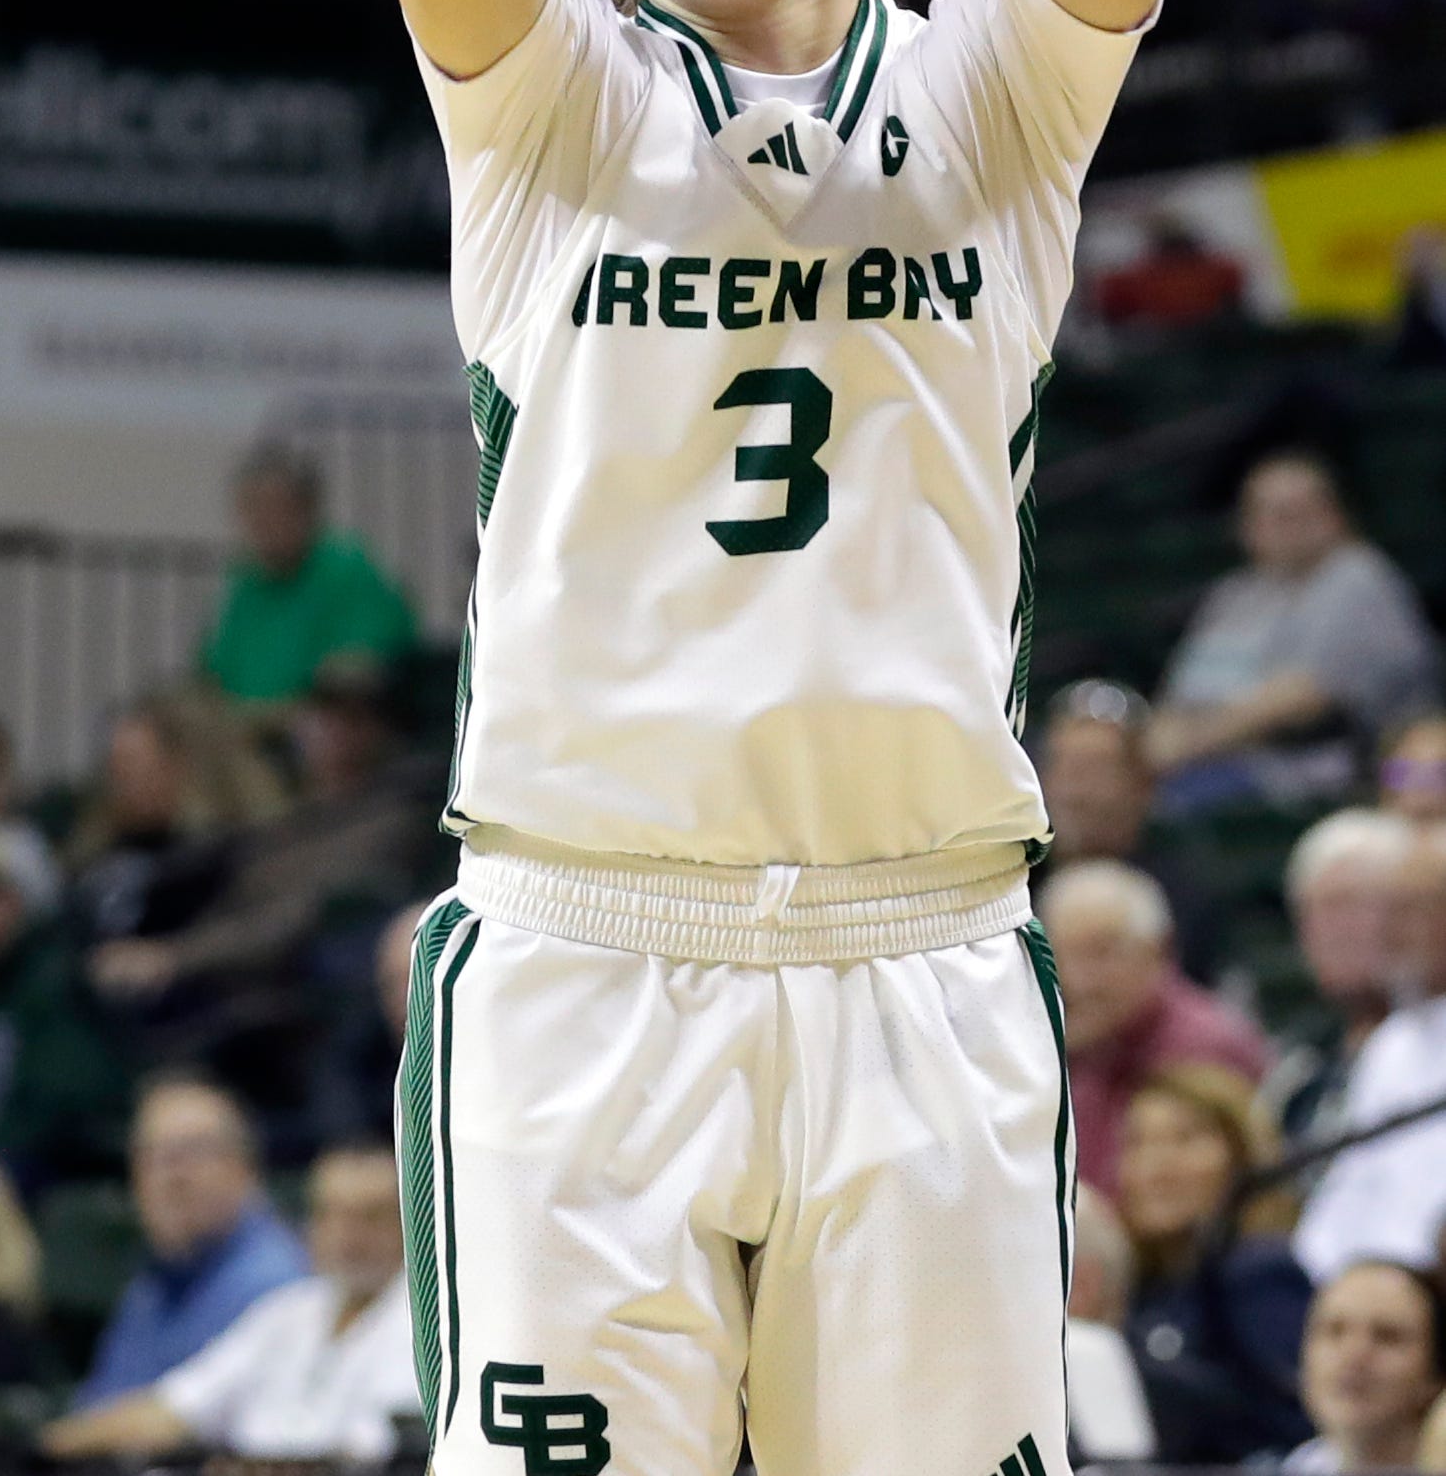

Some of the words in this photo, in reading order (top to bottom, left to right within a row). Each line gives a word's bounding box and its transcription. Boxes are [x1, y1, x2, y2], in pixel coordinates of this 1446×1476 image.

[847, 247, 983, 321] BAY
[705, 367, 833, 556] 3
[480, 1361, 612, 1476] GB
